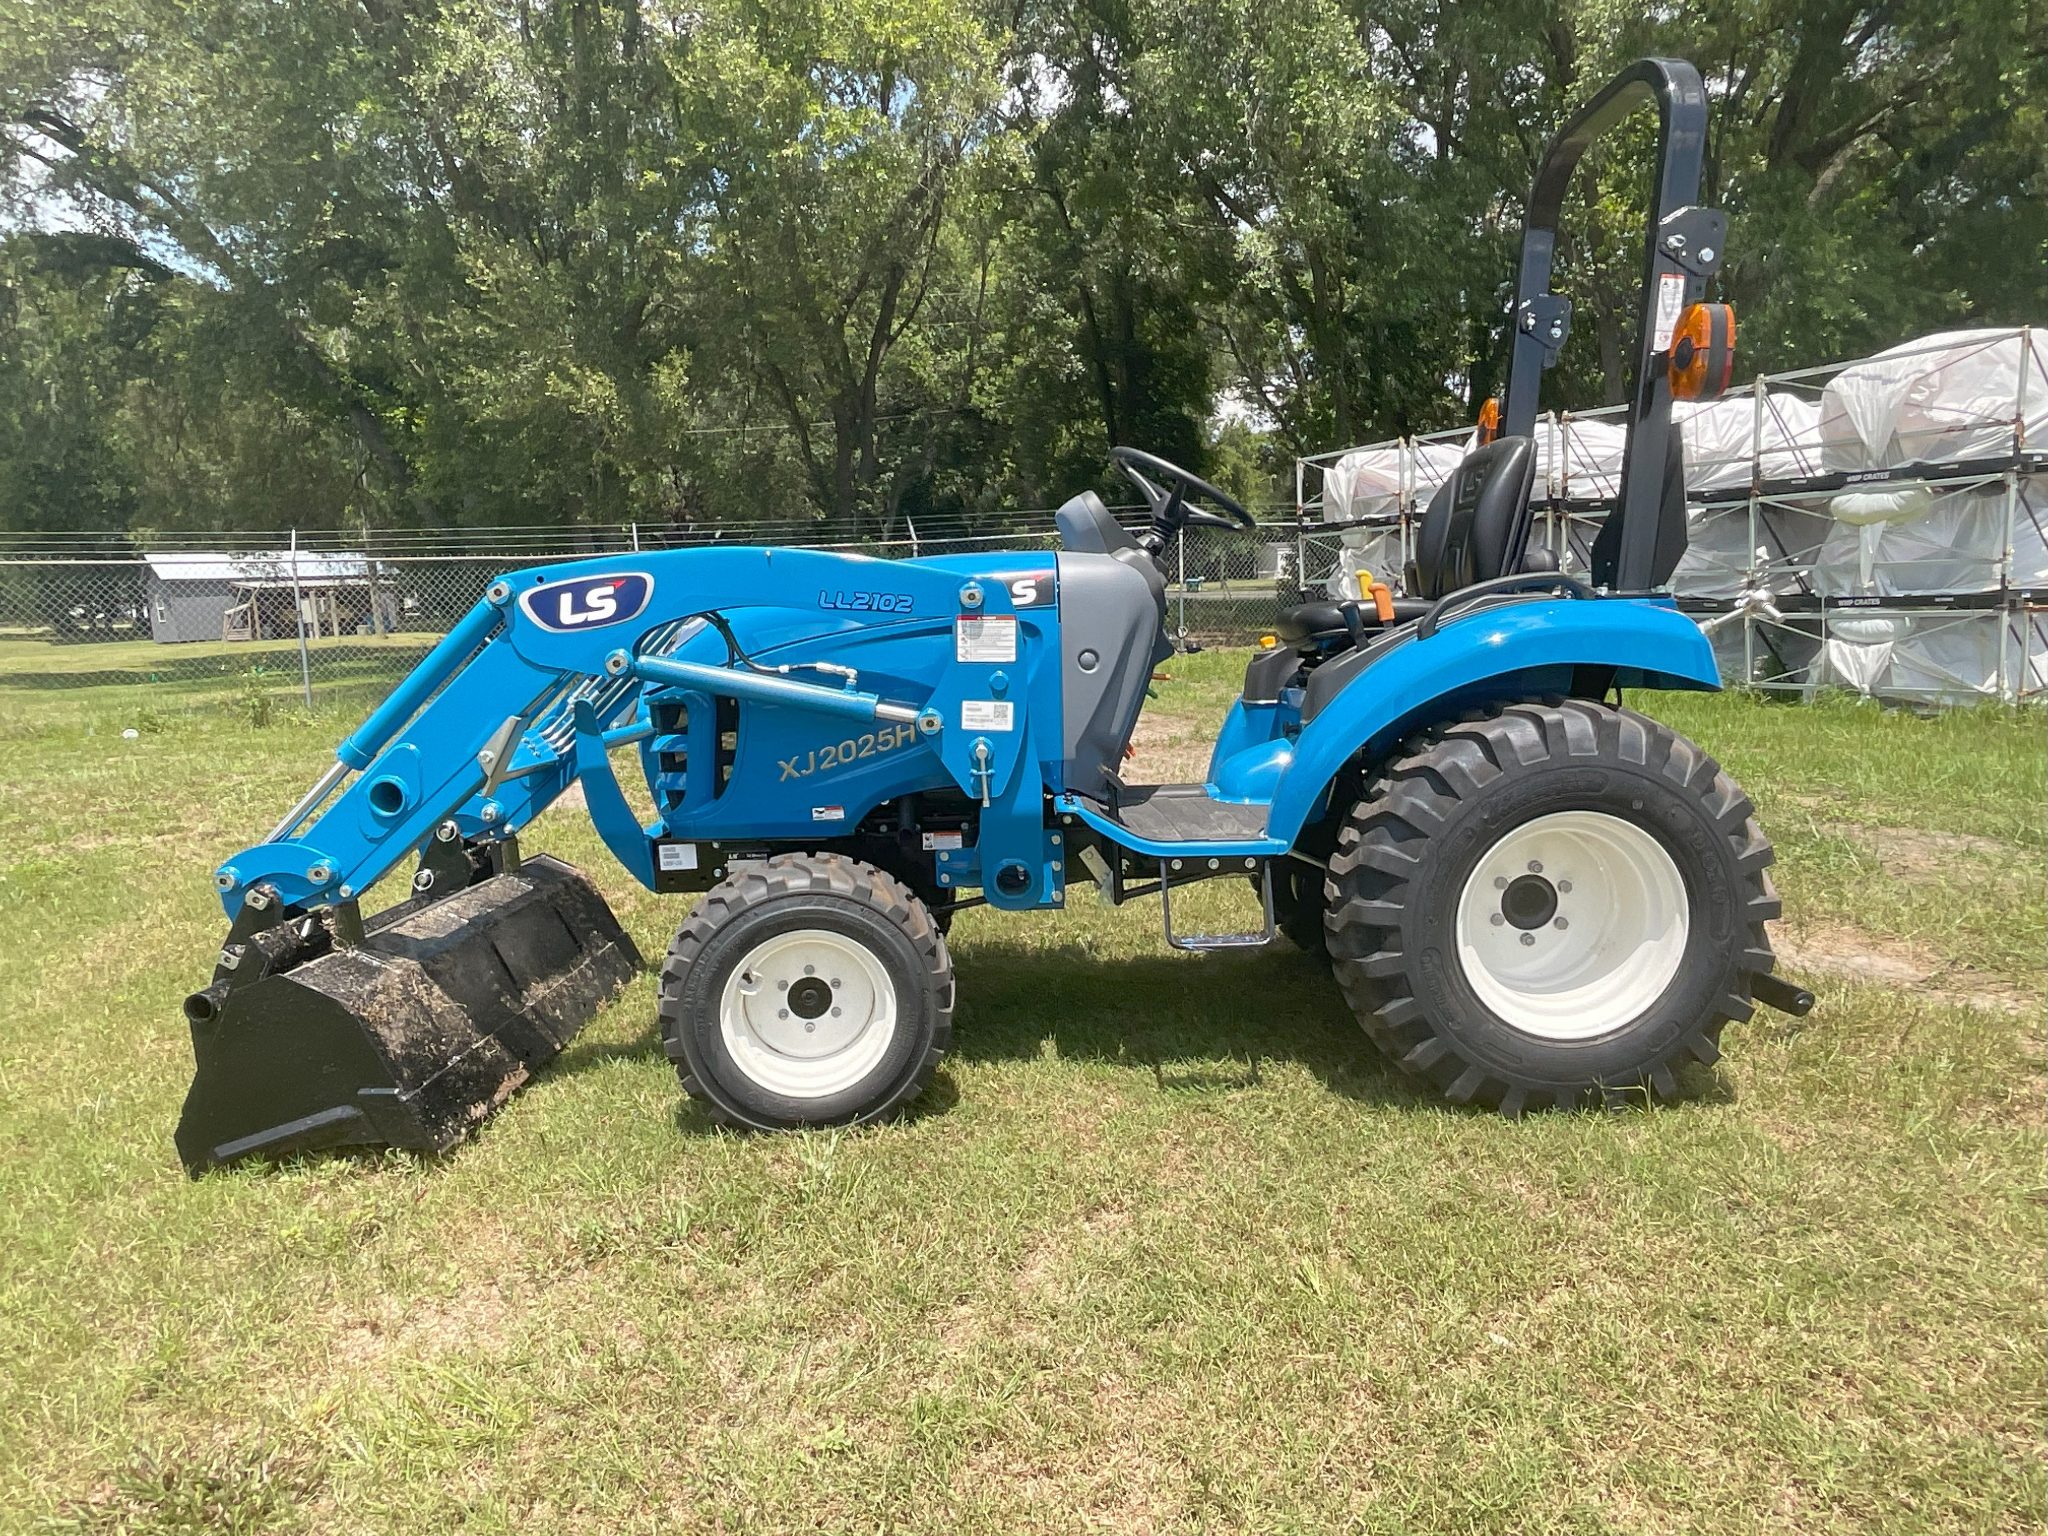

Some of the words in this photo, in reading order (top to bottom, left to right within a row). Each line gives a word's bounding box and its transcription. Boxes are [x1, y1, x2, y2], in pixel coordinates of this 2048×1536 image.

[559, 585, 617, 625] LS
[819, 590, 915, 614] LL2102
[1010, 579, 1037, 606] S
[777, 724, 917, 783] XJ2025H
